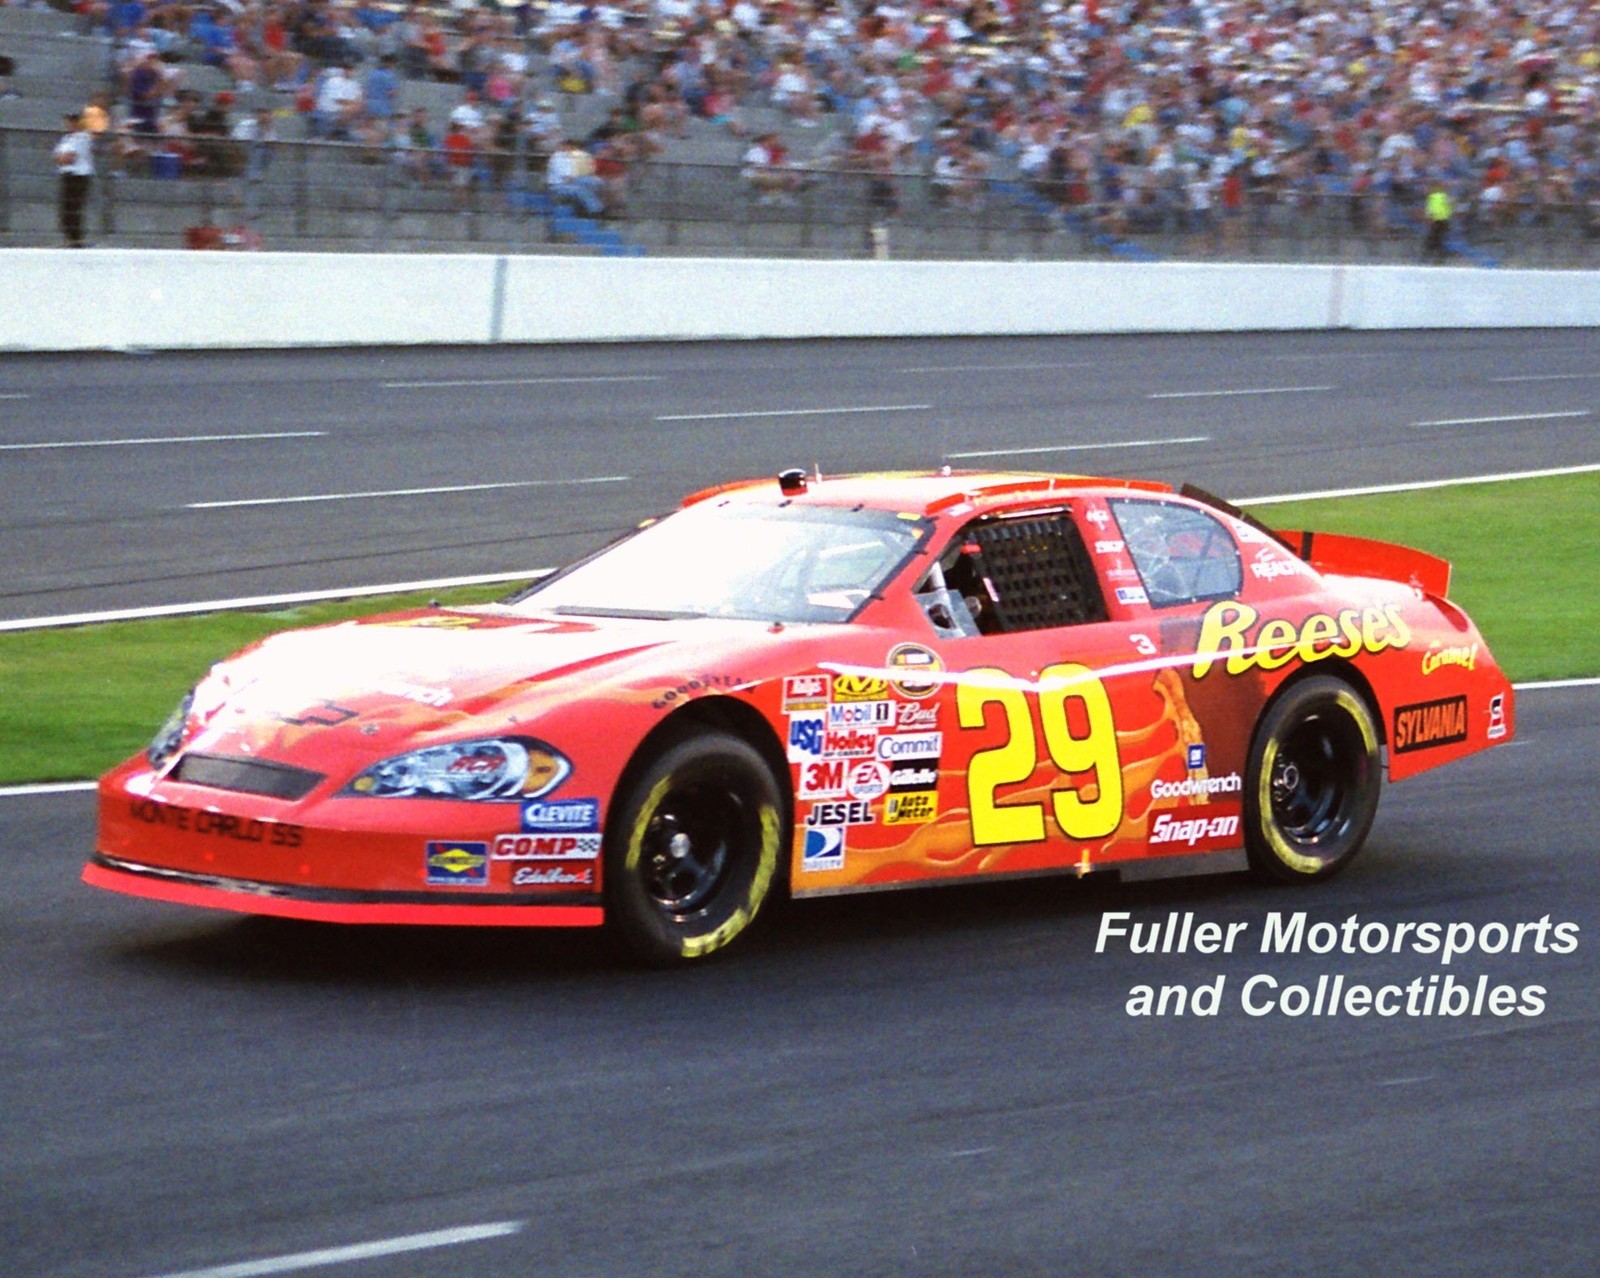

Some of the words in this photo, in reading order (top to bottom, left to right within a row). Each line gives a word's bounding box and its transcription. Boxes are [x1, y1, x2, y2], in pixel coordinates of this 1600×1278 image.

[1130, 634, 1157, 655] 3
[830, 704, 871, 723] Mobil
[1396, 700, 1465, 749] SYLVANIA
[824, 730, 876, 755] Holley
[877, 735, 939, 760] Commit
[956, 661, 1125, 846] 29
[805, 761, 843, 791] 3M
[856, 765, 883, 784] EA
[1150, 772, 1242, 799] Goodwrench
[525, 802, 595, 822] CLEVITE
[807, 801, 874, 826] JESEL
[1149, 814, 1239, 847] Snap-on
[495, 837, 577, 856] COMP
[512, 867, 593, 886] Edelbrok
